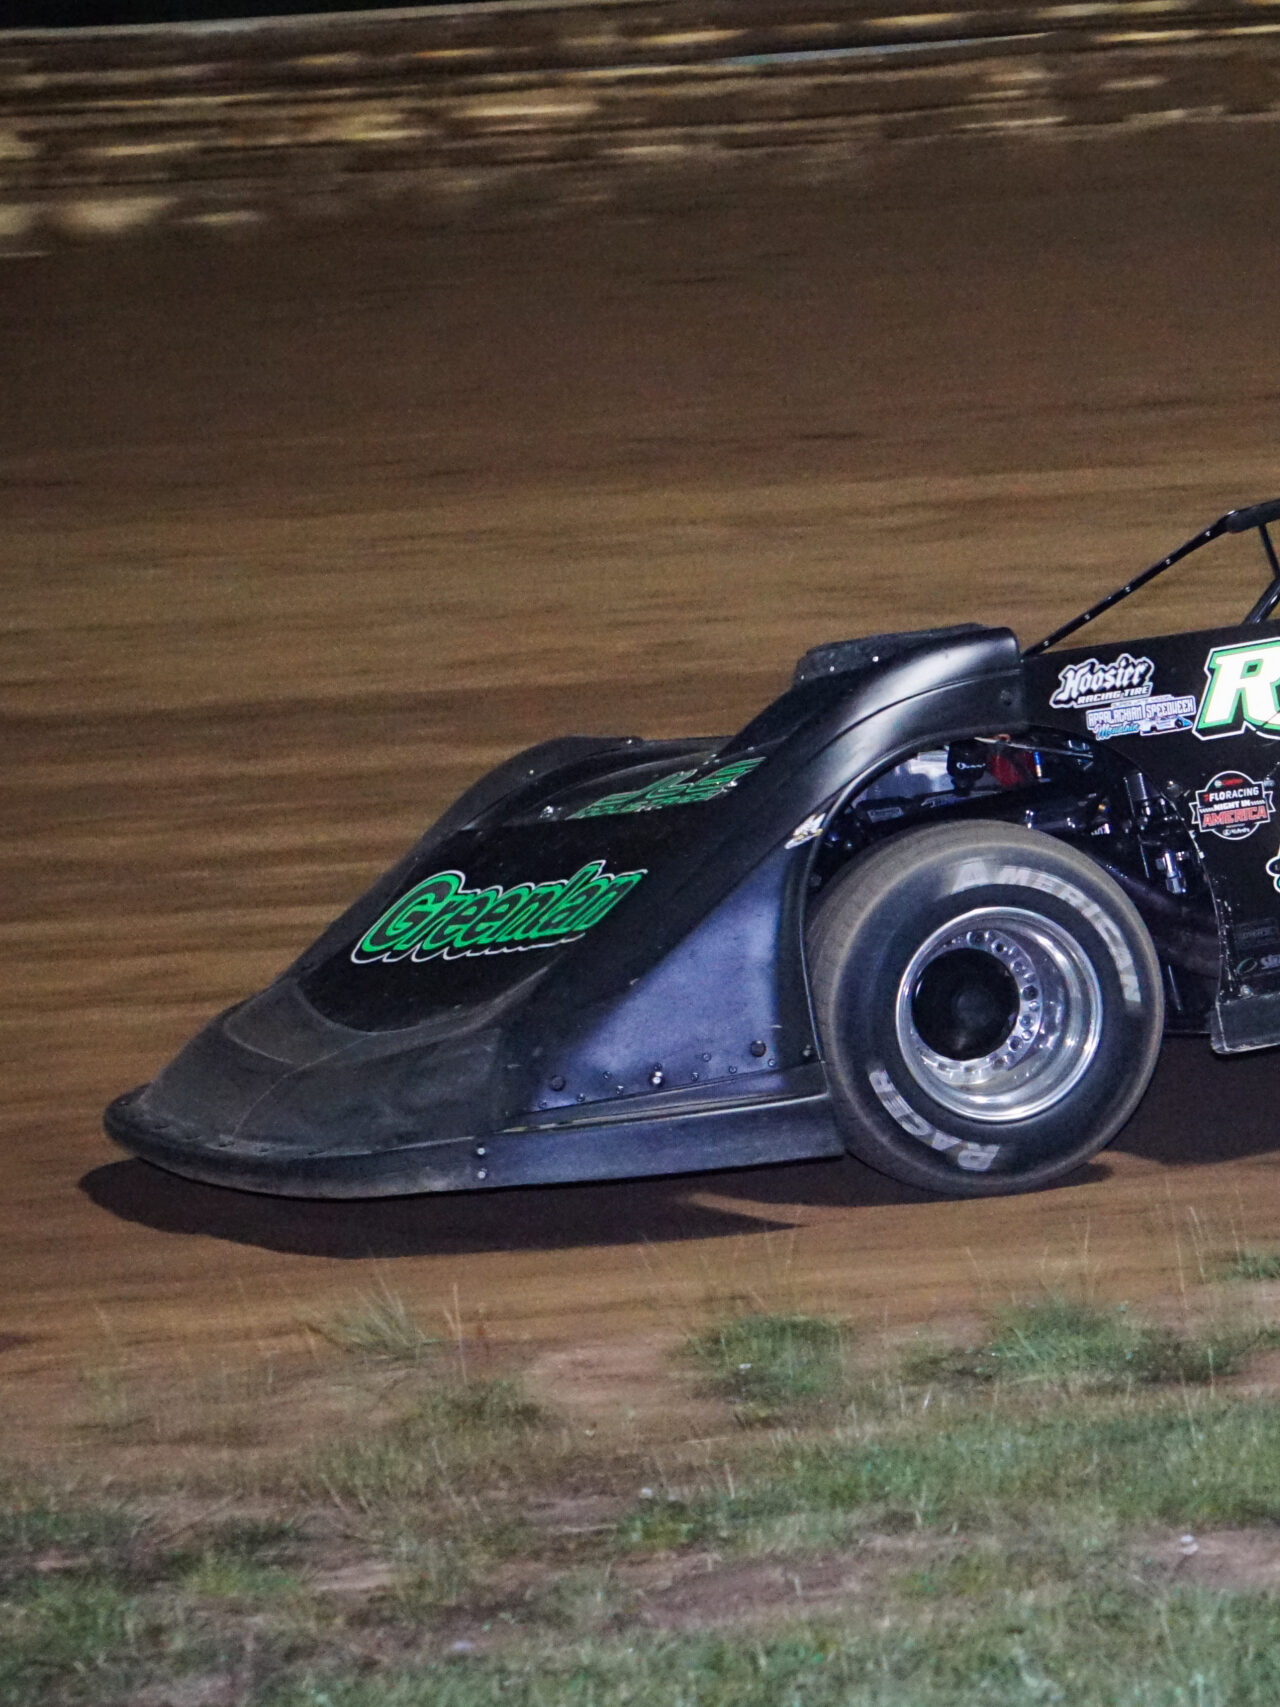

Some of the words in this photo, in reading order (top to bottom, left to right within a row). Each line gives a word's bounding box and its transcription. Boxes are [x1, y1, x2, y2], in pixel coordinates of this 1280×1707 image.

[1055, 657, 1149, 701] Hoosier
[1077, 690, 1121, 705] RACING
[1124, 685, 1150, 698] TIRE
[1088, 705, 1143, 728] APPALACHIAN
[1145, 699, 1194, 718] SPEEDWEEK
[1209, 787, 1259, 802] FLORACING
[1213, 801, 1240, 811] NIGHT
[1241, 799, 1251, 807] IN
[1202, 805, 1267, 827] AMERICA
[949, 857, 1142, 1006] AMERICAN
